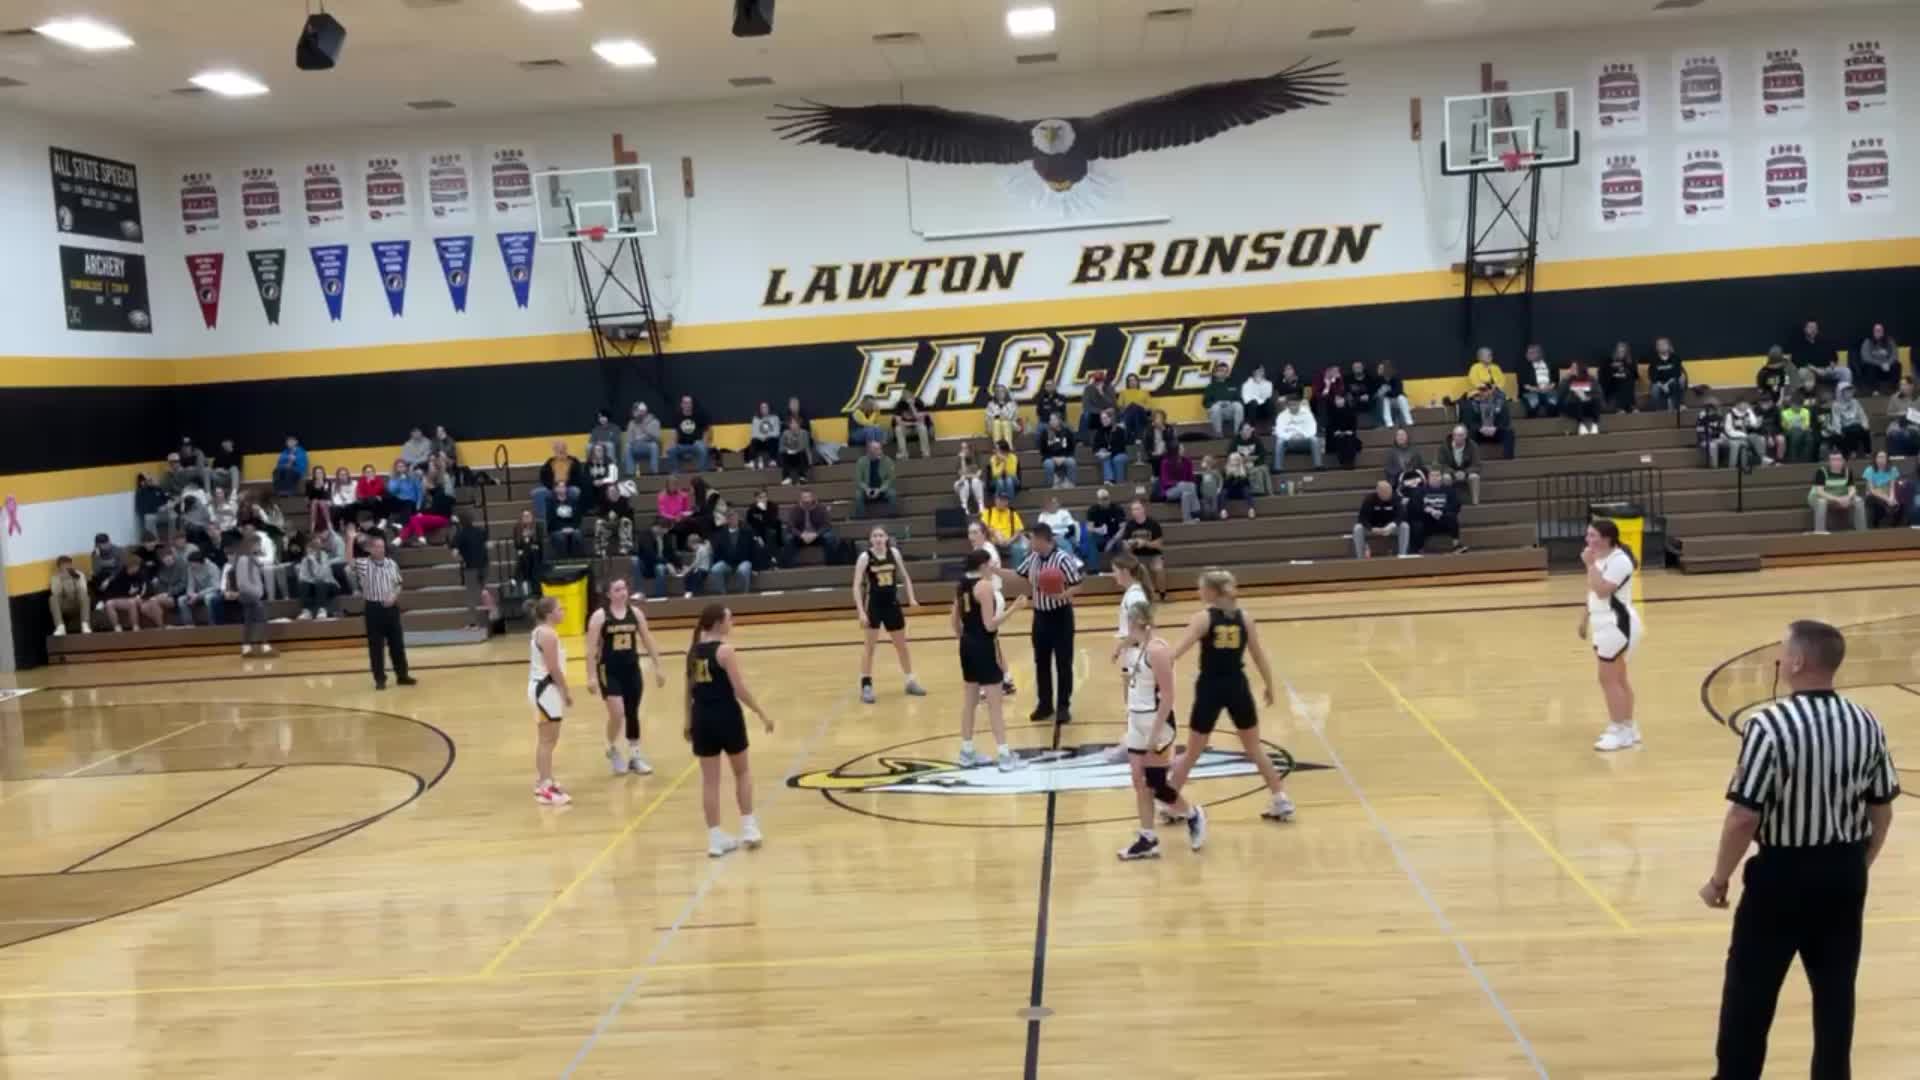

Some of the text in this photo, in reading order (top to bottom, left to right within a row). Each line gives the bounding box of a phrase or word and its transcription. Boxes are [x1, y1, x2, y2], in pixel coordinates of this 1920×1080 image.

[53, 151, 136, 189] ALL STATE SPEECH
[84, 253, 126, 279] ARCHERY
[761, 222, 1383, 307] LAWTON BRONSON
[841, 318, 1248, 413] EAGLES
